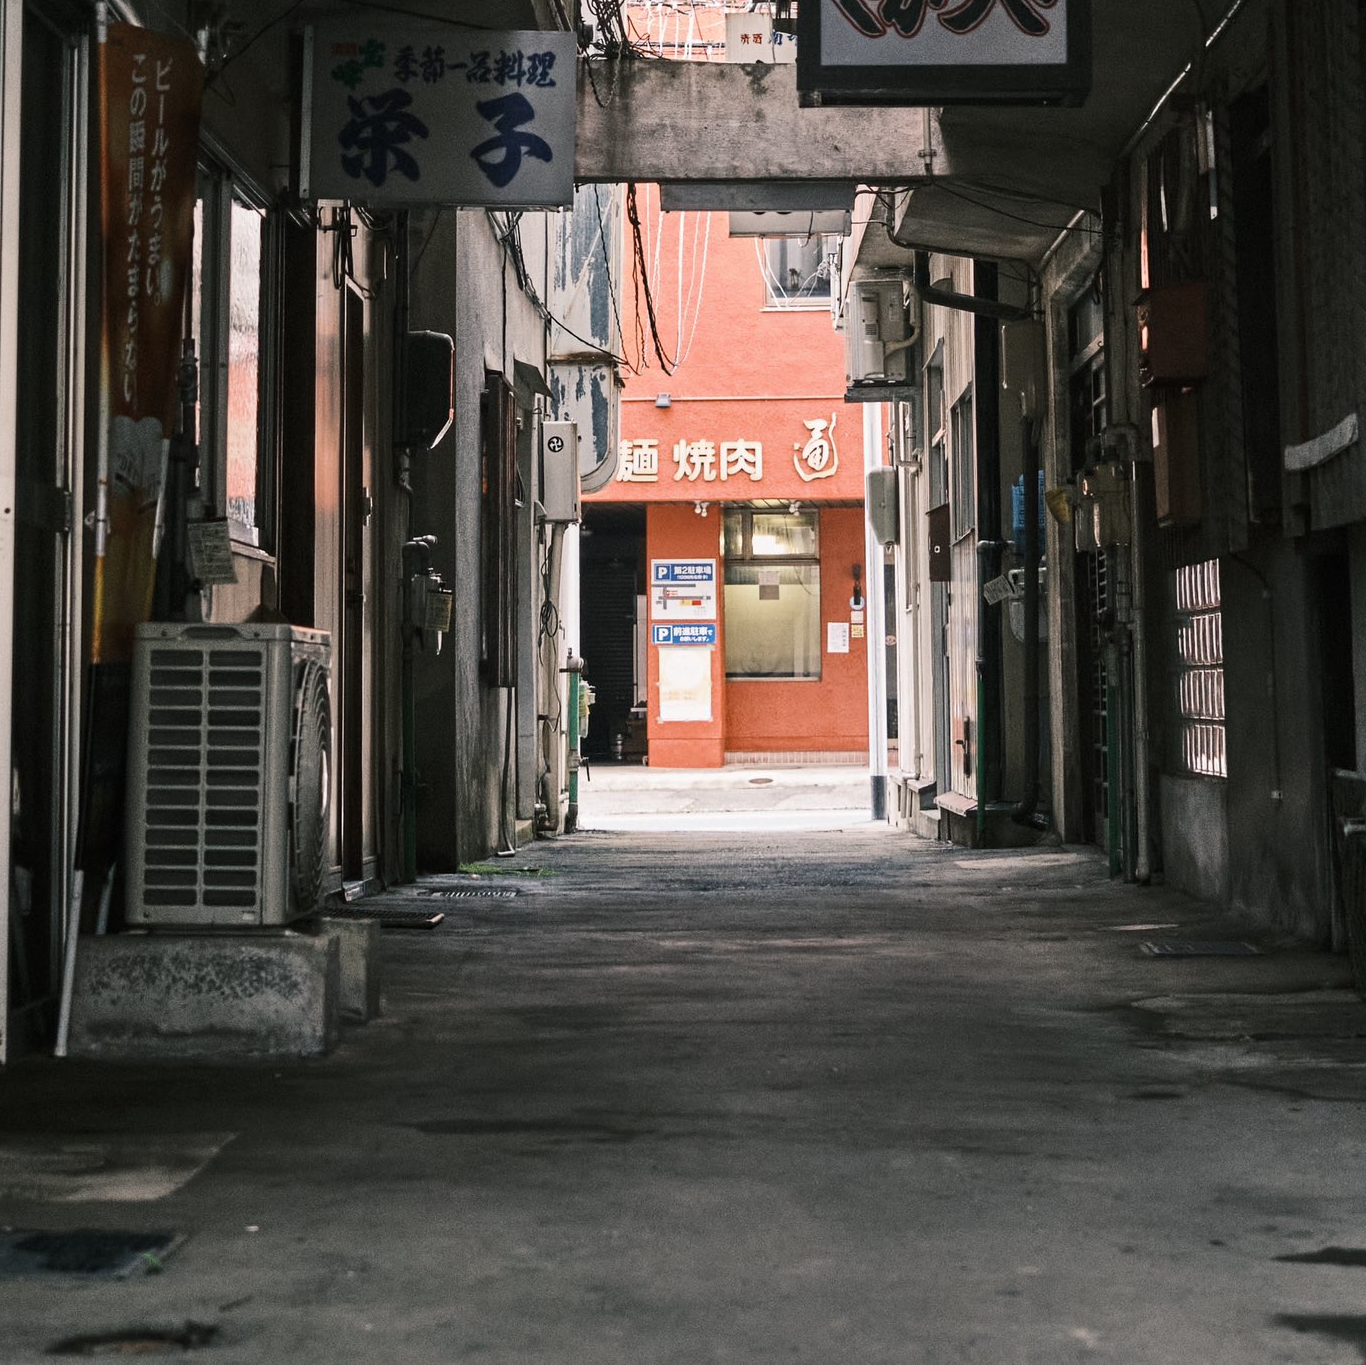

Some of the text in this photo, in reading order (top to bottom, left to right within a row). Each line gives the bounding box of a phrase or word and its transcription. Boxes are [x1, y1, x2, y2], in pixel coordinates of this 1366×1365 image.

[393, 45, 557, 88] 季節一品料理
[338, 88, 554, 189] 栄子
[145, 56, 173, 307] ビールがうまい。
[673, 438, 764, 482] 焼肉
